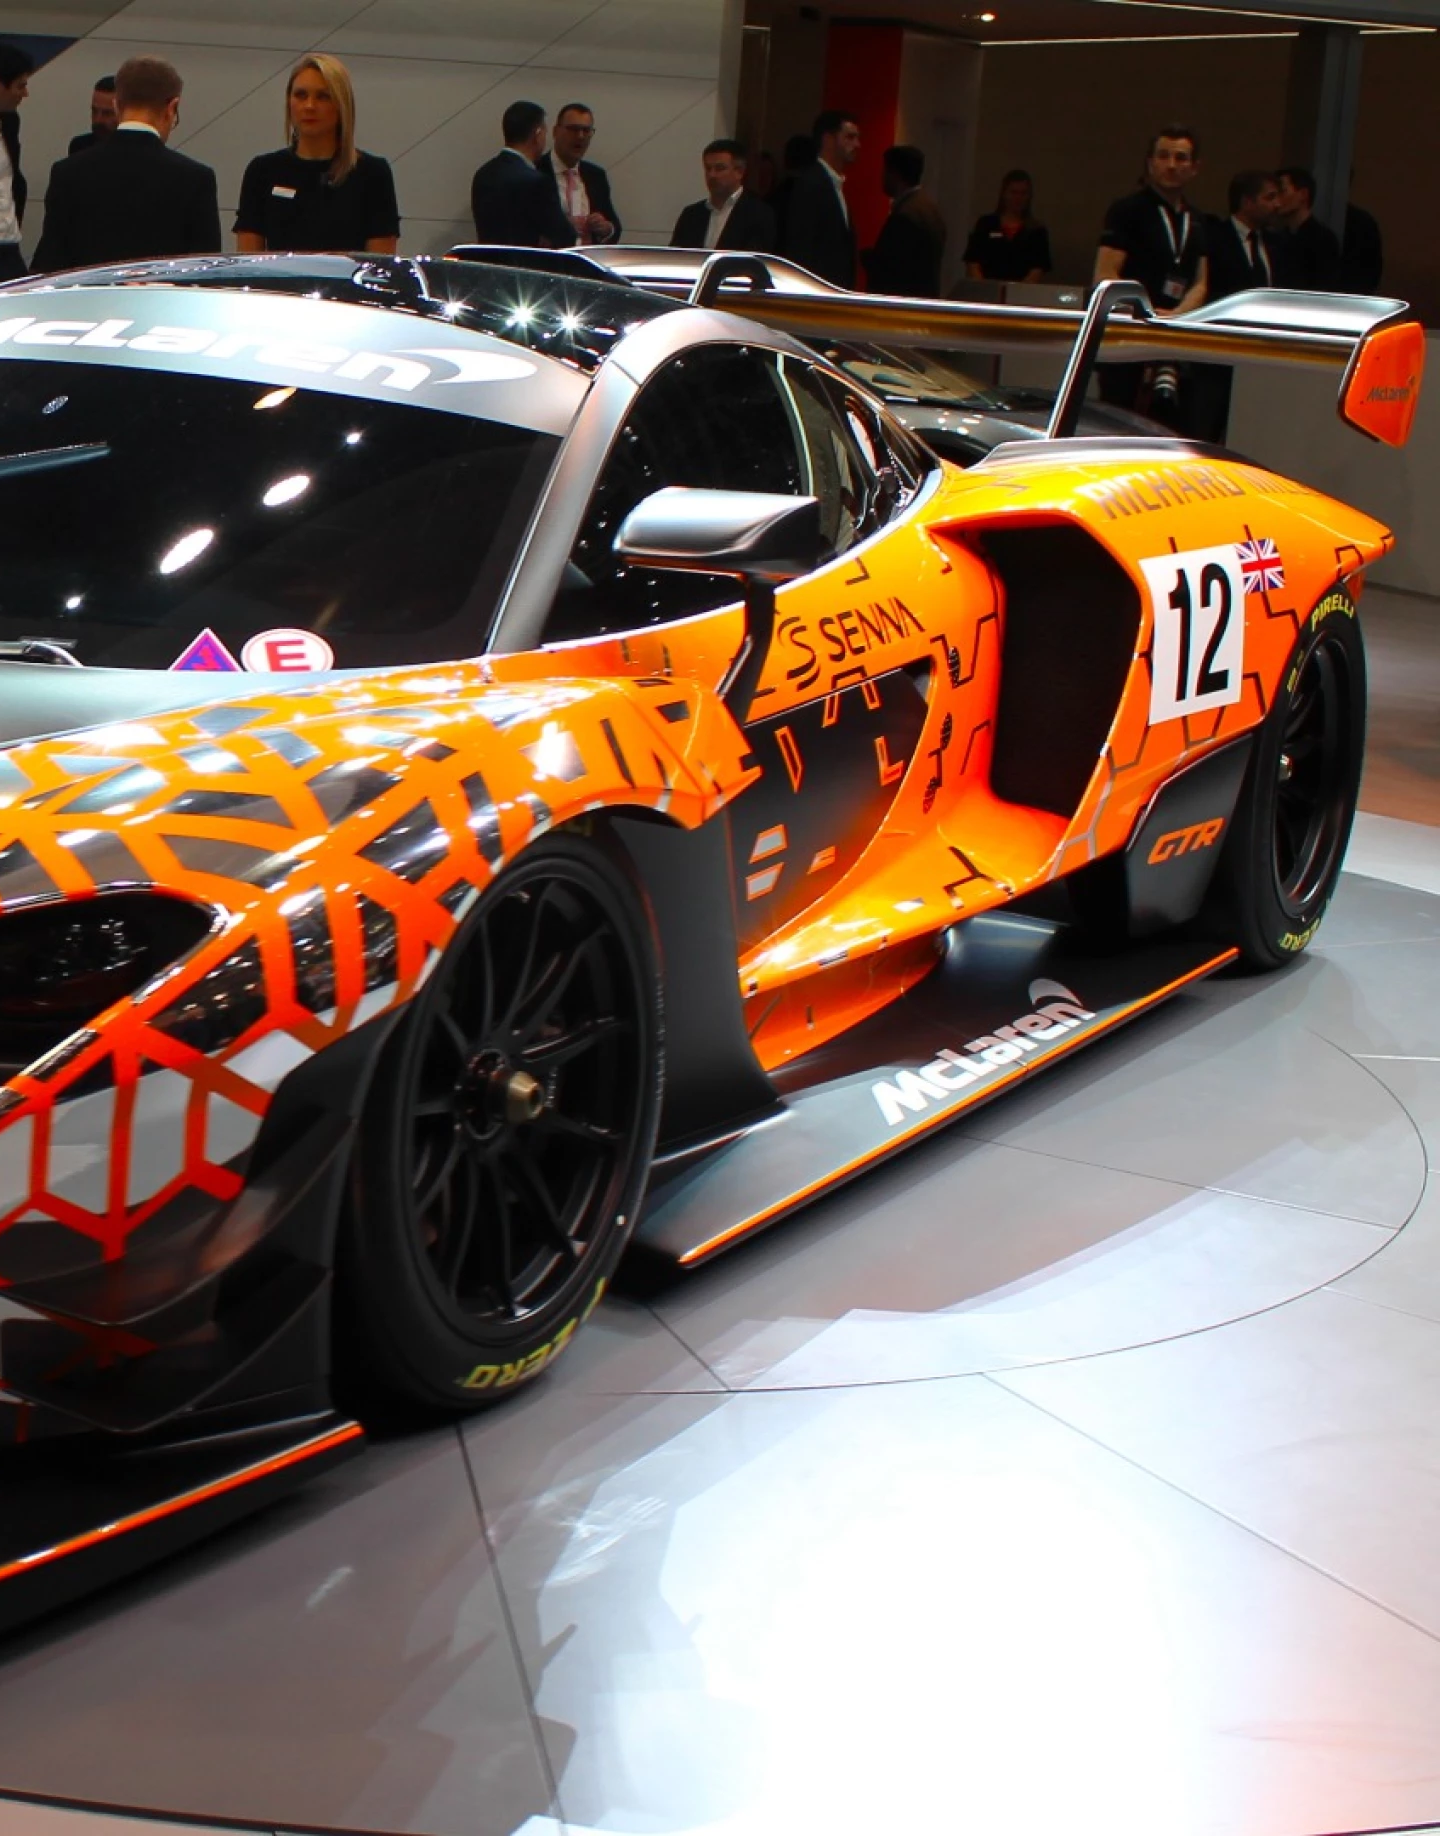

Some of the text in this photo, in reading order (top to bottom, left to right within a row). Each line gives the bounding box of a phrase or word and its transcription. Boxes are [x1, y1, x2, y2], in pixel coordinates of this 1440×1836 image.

[1074, 464, 1248, 520] RICHARD
[818, 596, 926, 662] SENNA
[1168, 562, 1232, 703] 12
[1311, 593, 1354, 632] PIRELLI
[264, 639, 312, 673] E
[1147, 817, 1225, 865] GTR
[871, 1001, 1097, 1126] McLaren
